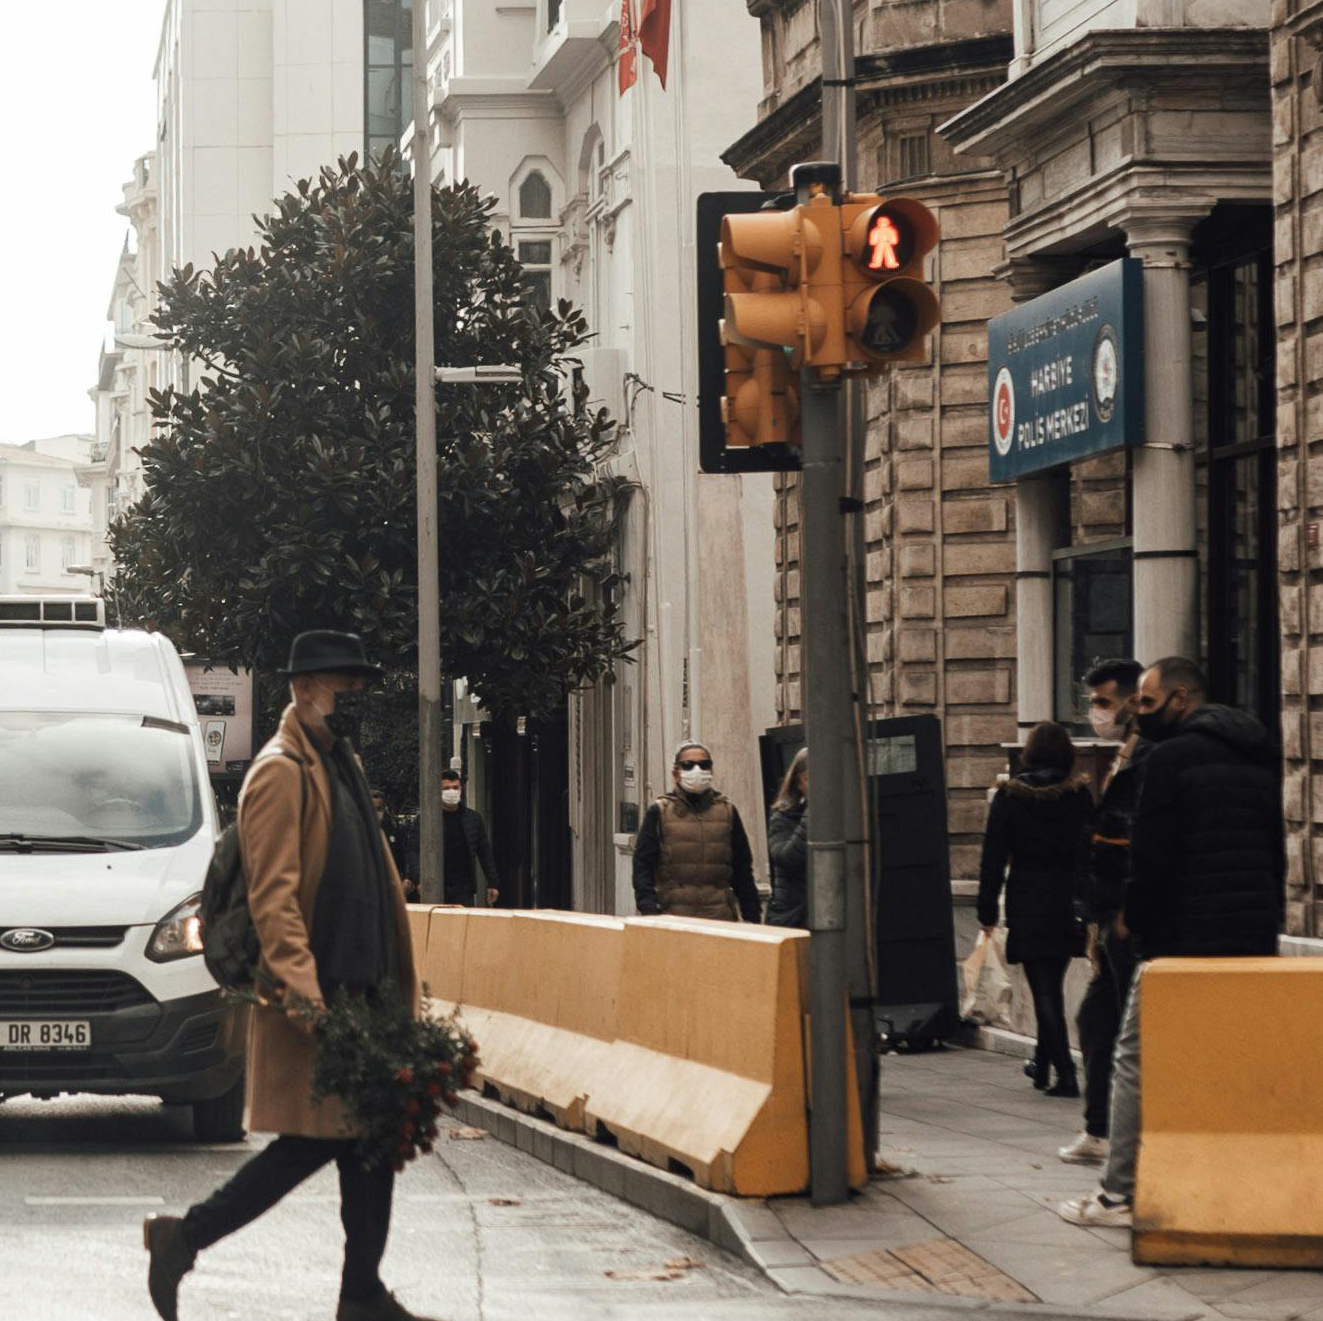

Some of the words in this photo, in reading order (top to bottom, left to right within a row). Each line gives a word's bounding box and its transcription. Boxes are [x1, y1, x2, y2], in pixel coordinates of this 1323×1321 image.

[1018, 411, 1044, 452] POLİS
[1046, 391, 1089, 442] MERKEZİ
[11, 931, 42, 945] Ford
[8, 1023, 31, 1044] DR
[39, 1023, 86, 1044] 8346
